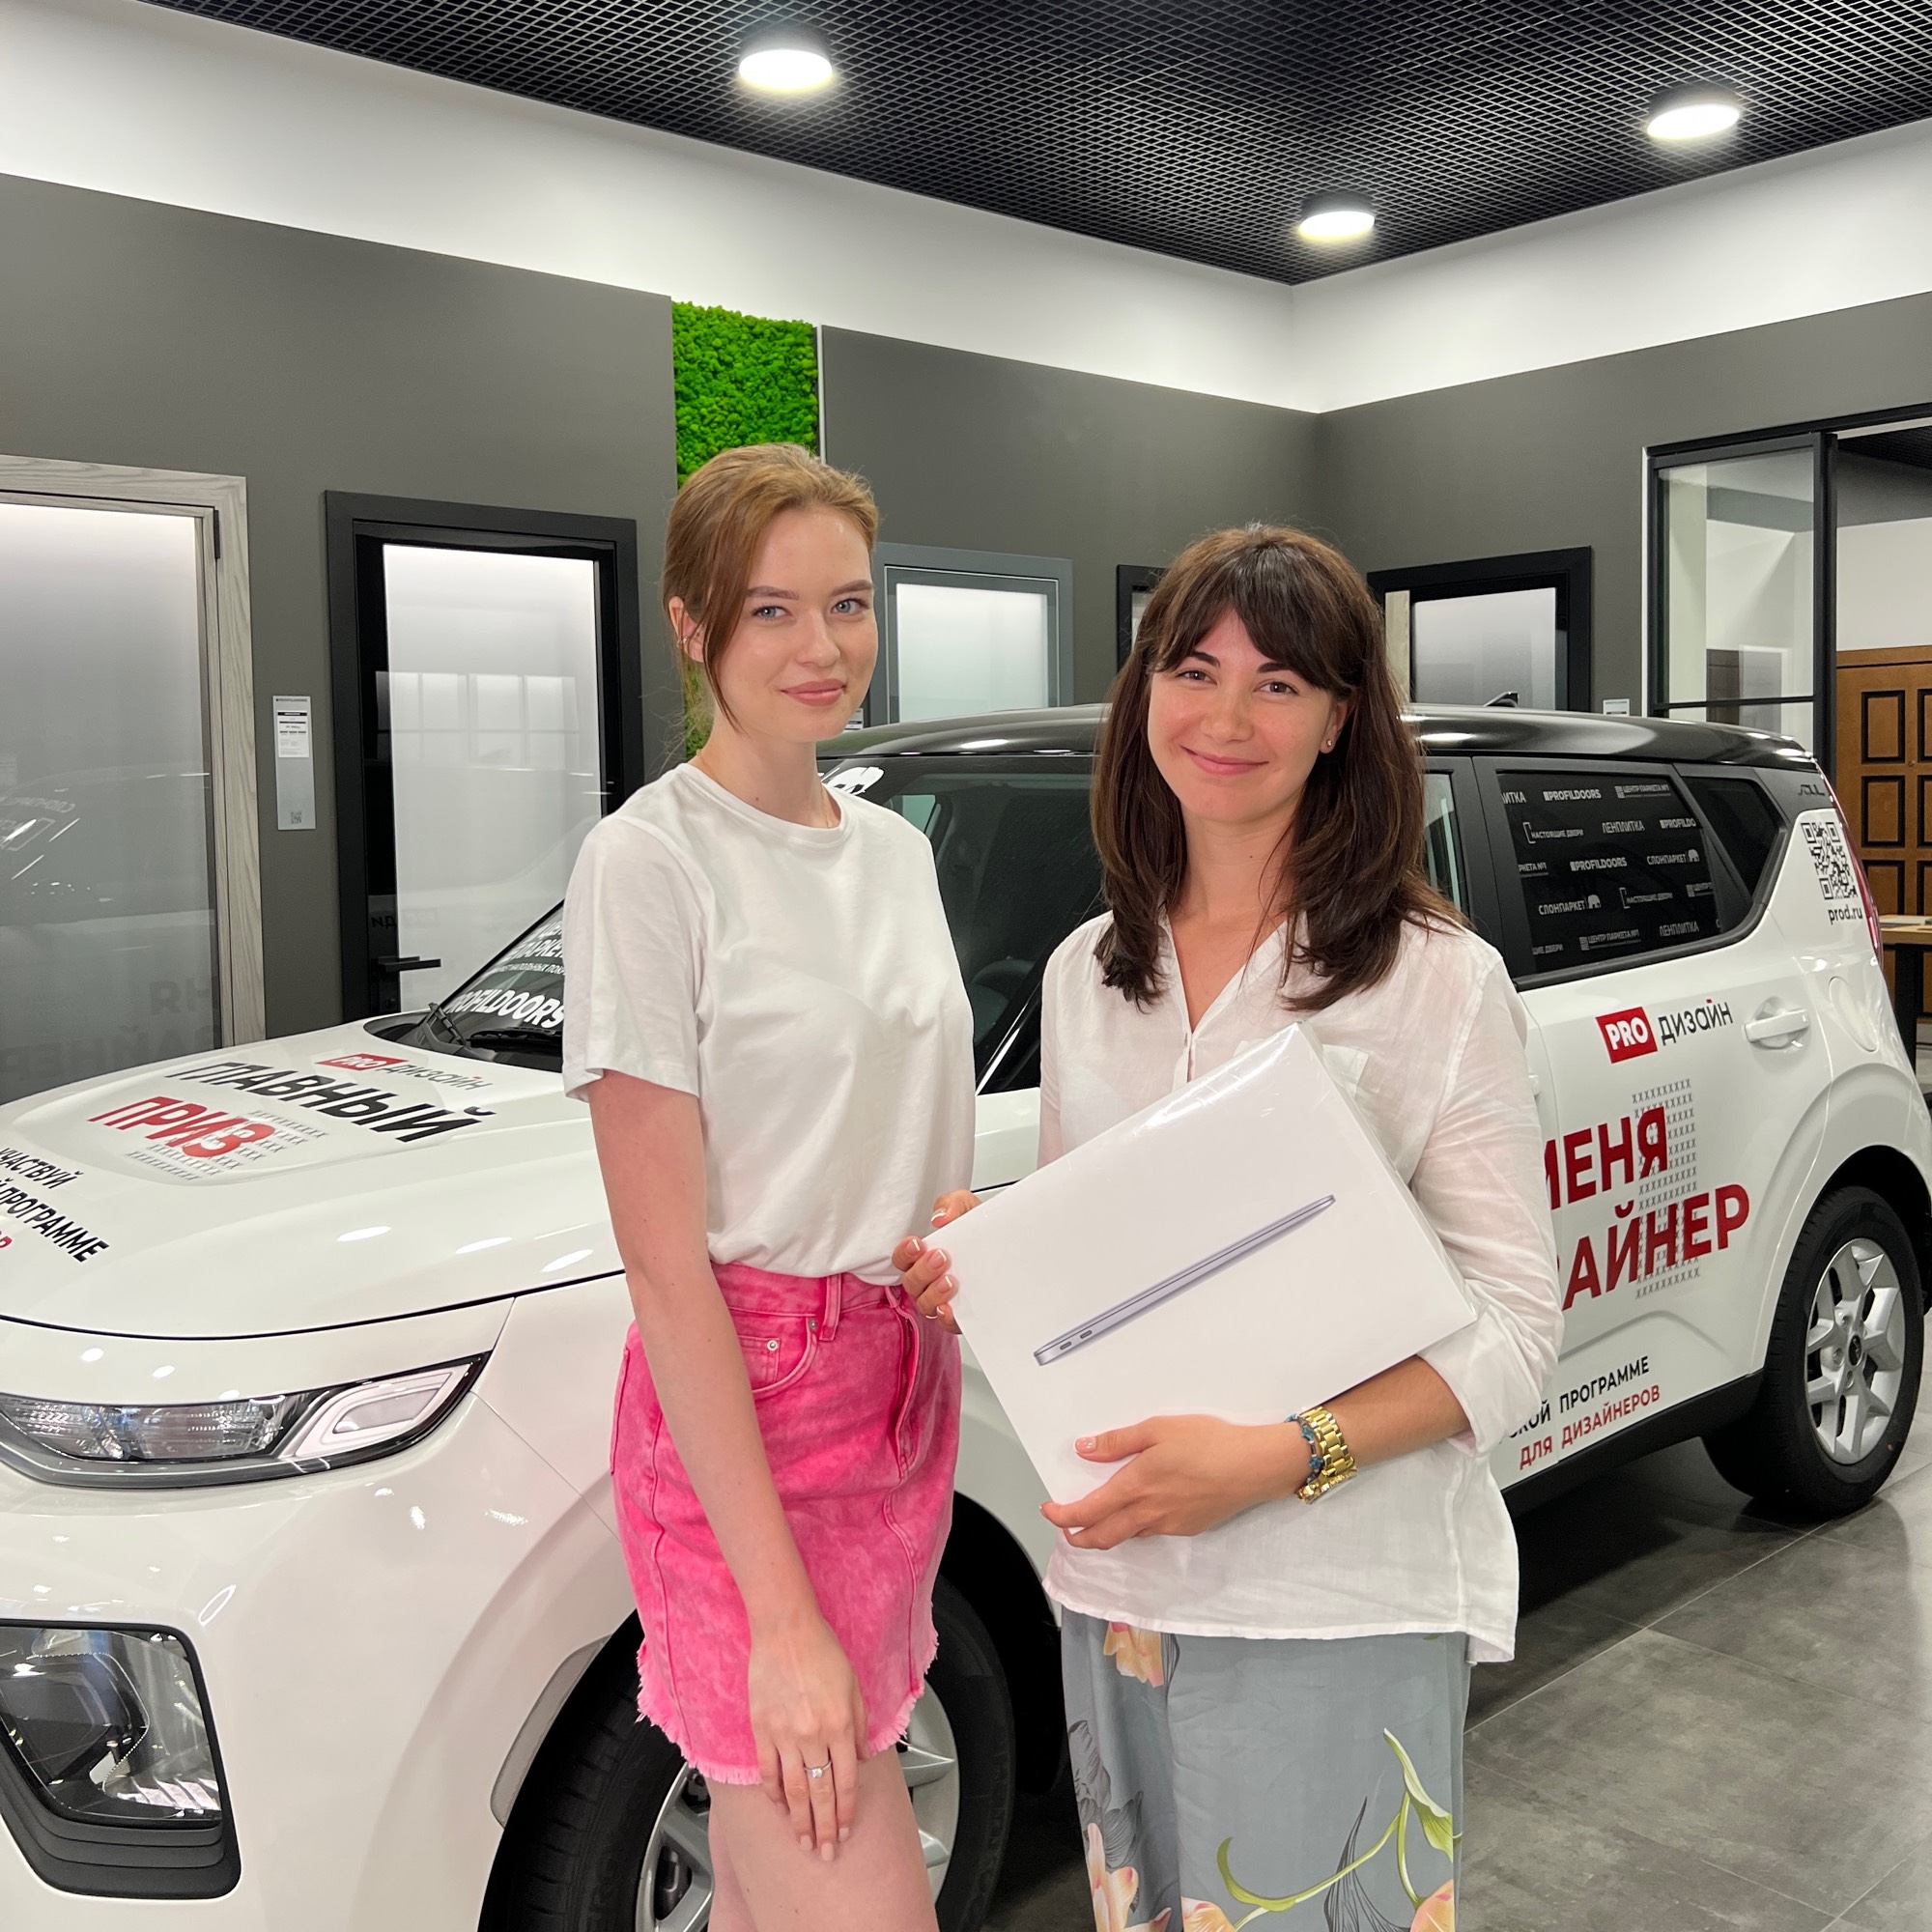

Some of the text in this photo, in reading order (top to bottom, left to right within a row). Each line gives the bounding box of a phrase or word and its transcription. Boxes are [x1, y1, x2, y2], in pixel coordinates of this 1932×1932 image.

[1549, 789, 1602, 801] PROFILDOORS
[1576, 857, 1628, 870] PROFILDOORS
[1828, 904, 1863, 925] prod.ru
[1605, 1017, 1648, 1050] PRO
[88, 1095, 276, 1158] ПРИЗ
[164, 1062, 497, 1143] ГЛАВНЫЙ
[1556, 1183, 1750, 1312] АЙНЕР
[1558, 1355, 1650, 1414] ПРОГРАММЕ
[1519, 1383, 1661, 1471] ДЛЯ ДИЗАЙНЕРОВ
